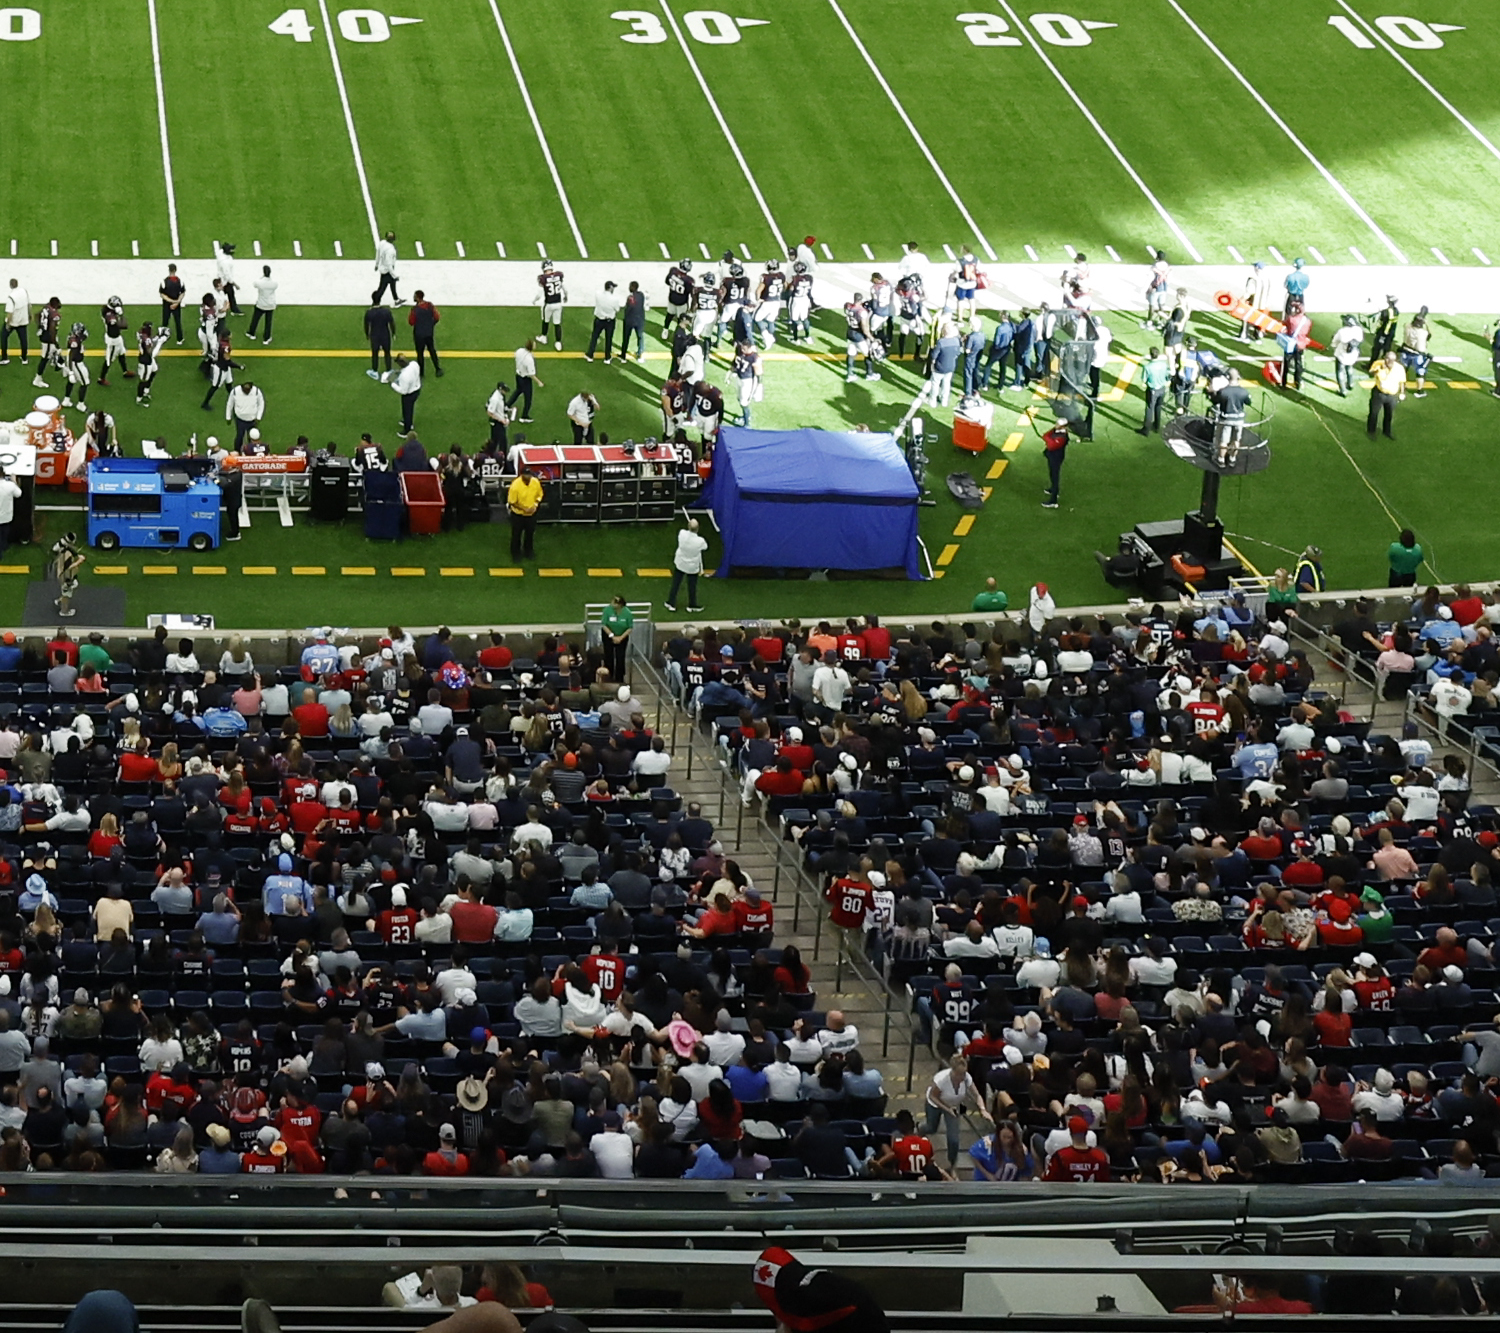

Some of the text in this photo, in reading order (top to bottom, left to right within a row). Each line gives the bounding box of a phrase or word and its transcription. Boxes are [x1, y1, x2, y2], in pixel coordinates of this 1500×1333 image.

[268, 7, 392, 44] 40
[609, 9, 743, 47] 30
[955, 11, 1095, 49] 20
[1327, 13, 1446, 51] 10
